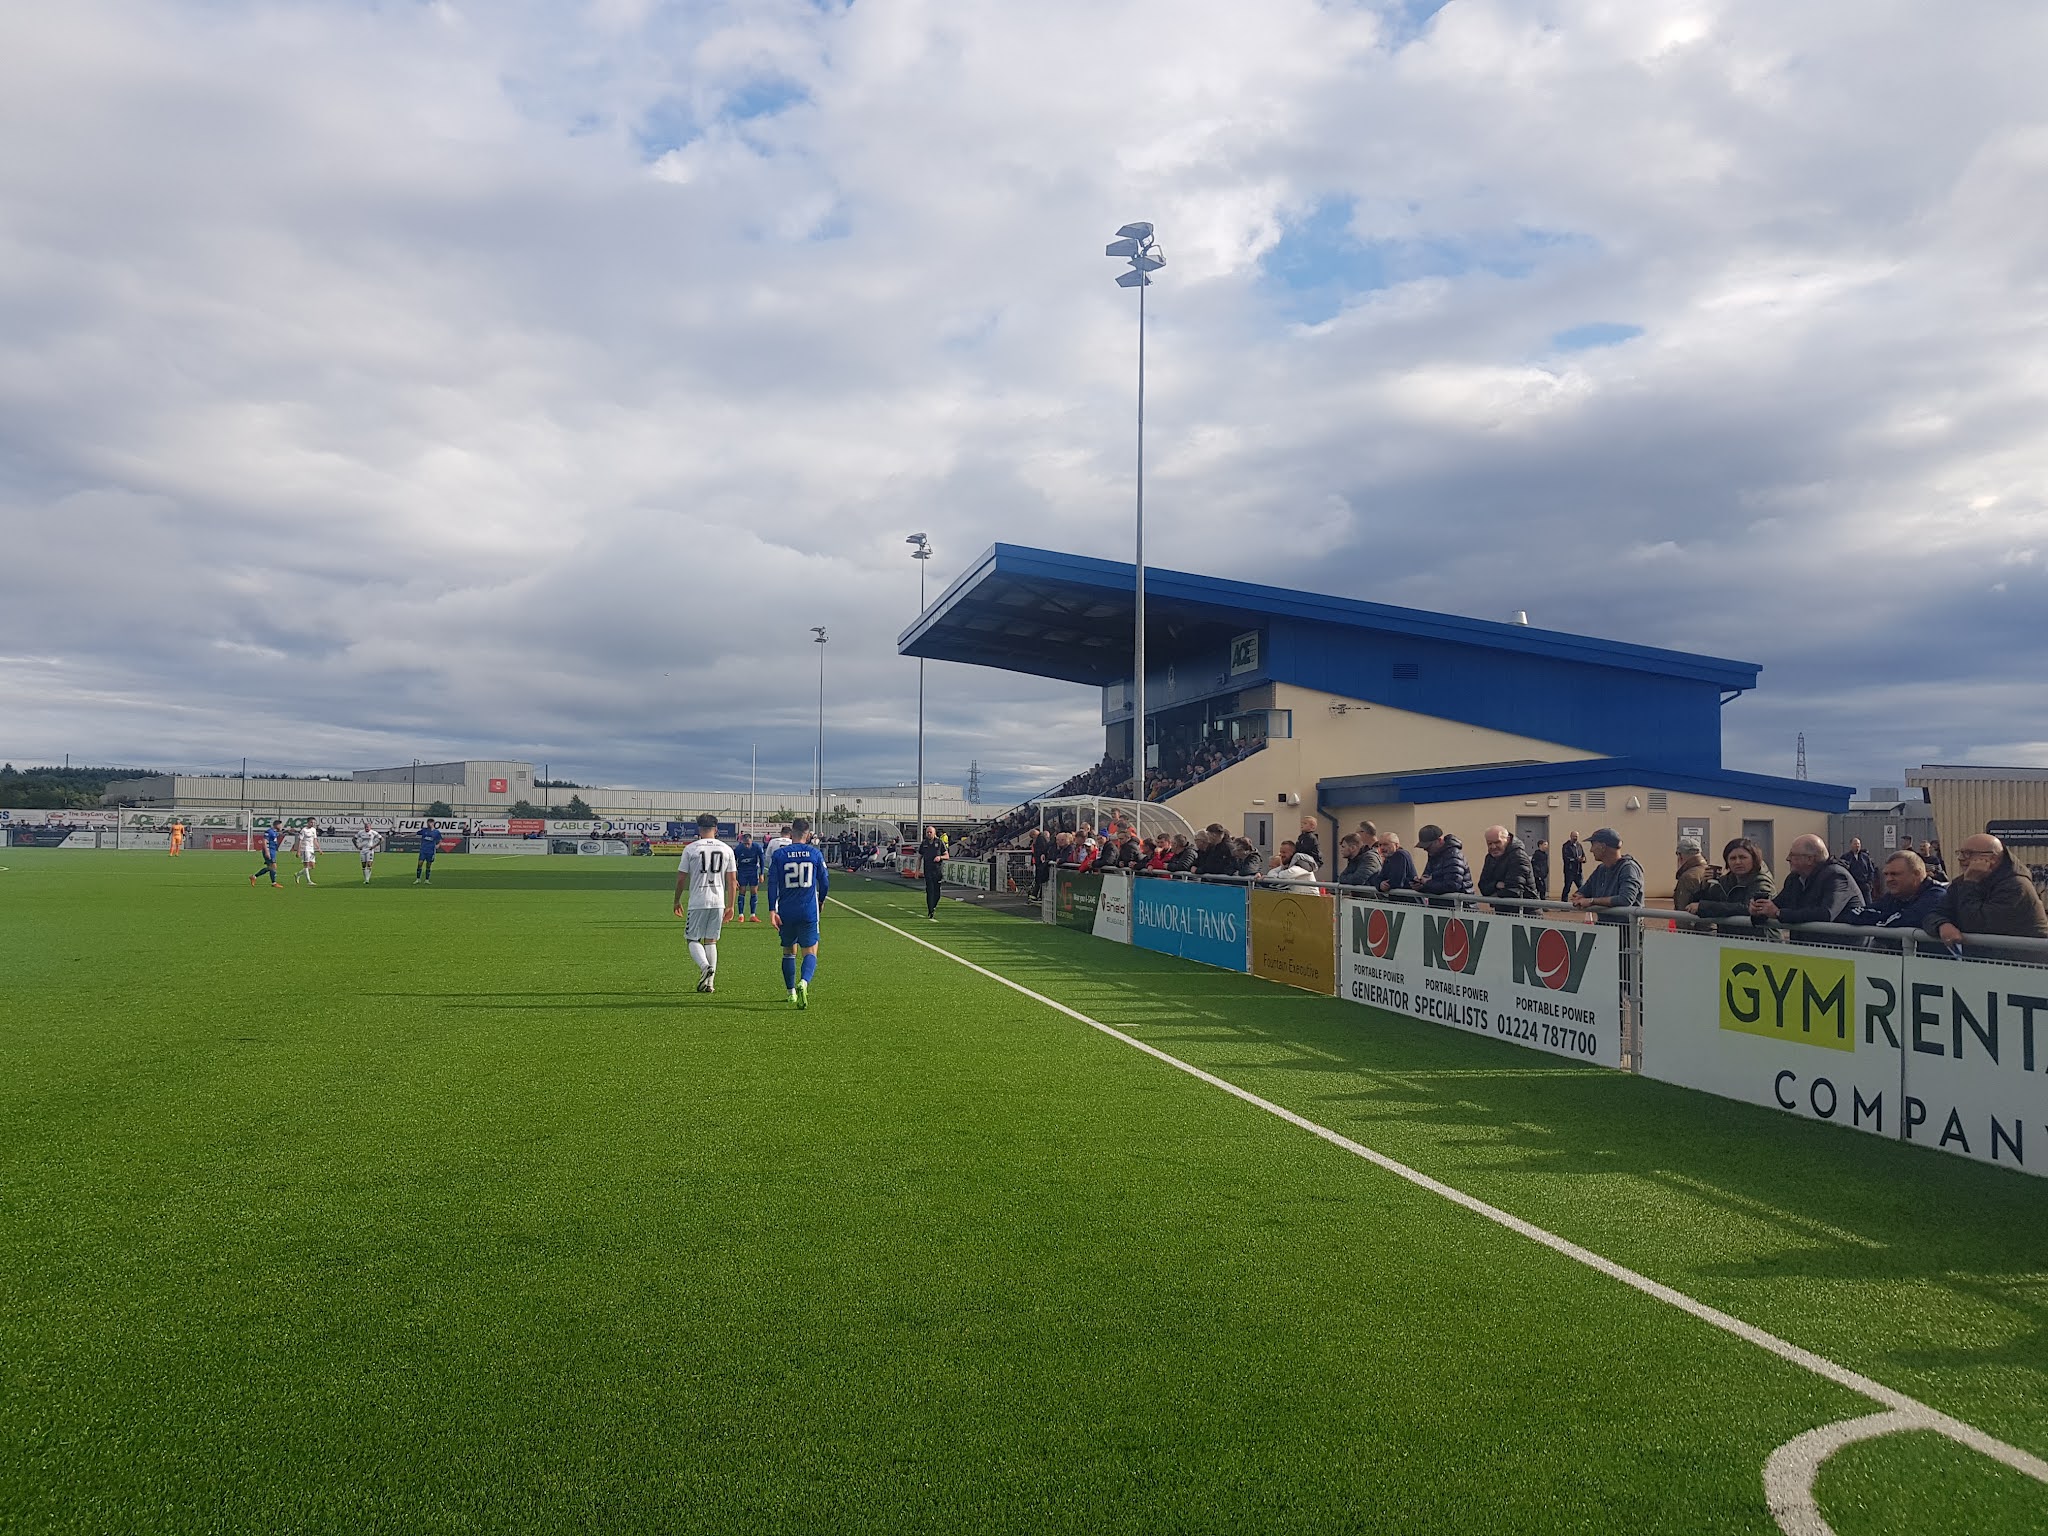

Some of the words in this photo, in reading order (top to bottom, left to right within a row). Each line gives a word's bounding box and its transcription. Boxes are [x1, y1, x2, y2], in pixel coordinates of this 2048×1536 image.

[1232, 640, 1251, 668] ACE
[128, 814, 155, 825] ACE
[201, 815, 227, 825] ACE
[554, 822, 589, 830] CABLE
[594, 822, 660, 831] SOLUTIONS
[699, 851, 724, 873] 10
[784, 862, 813, 888] 20
[1139, 900, 1193, 934] BALMORAL
[1197, 908, 1236, 943] TANKS
[1352, 905, 1406, 961] NOV
[1423, 914, 1490, 976] NOV
[1511, 924, 1597, 995] NOV
[1263, 953, 1288, 970] Fountain
[1288, 959, 1319, 980] Executive
[1353, 964, 1383, 980] PORTABLE
[1383, 969, 1405, 985] POWER
[1425, 979, 1461, 996] PORTABLE
[1462, 987, 1489, 1003] POWER
[1351, 981, 1409, 1010] GENERATOR
[1414, 995, 1489, 1029] SPECIALISTS
[1497, 1013, 1538, 1042] 01224
[1541, 1023, 1597, 1056] 787700
[1515, 997, 1560, 1018] PORTABLE
[1561, 1006, 1596, 1026] POWER
[1726, 962, 1846, 1039] GYM
[1865, 976, 2048, 1074] RENT
[1774, 1070, 2048, 1166] COMPAN
